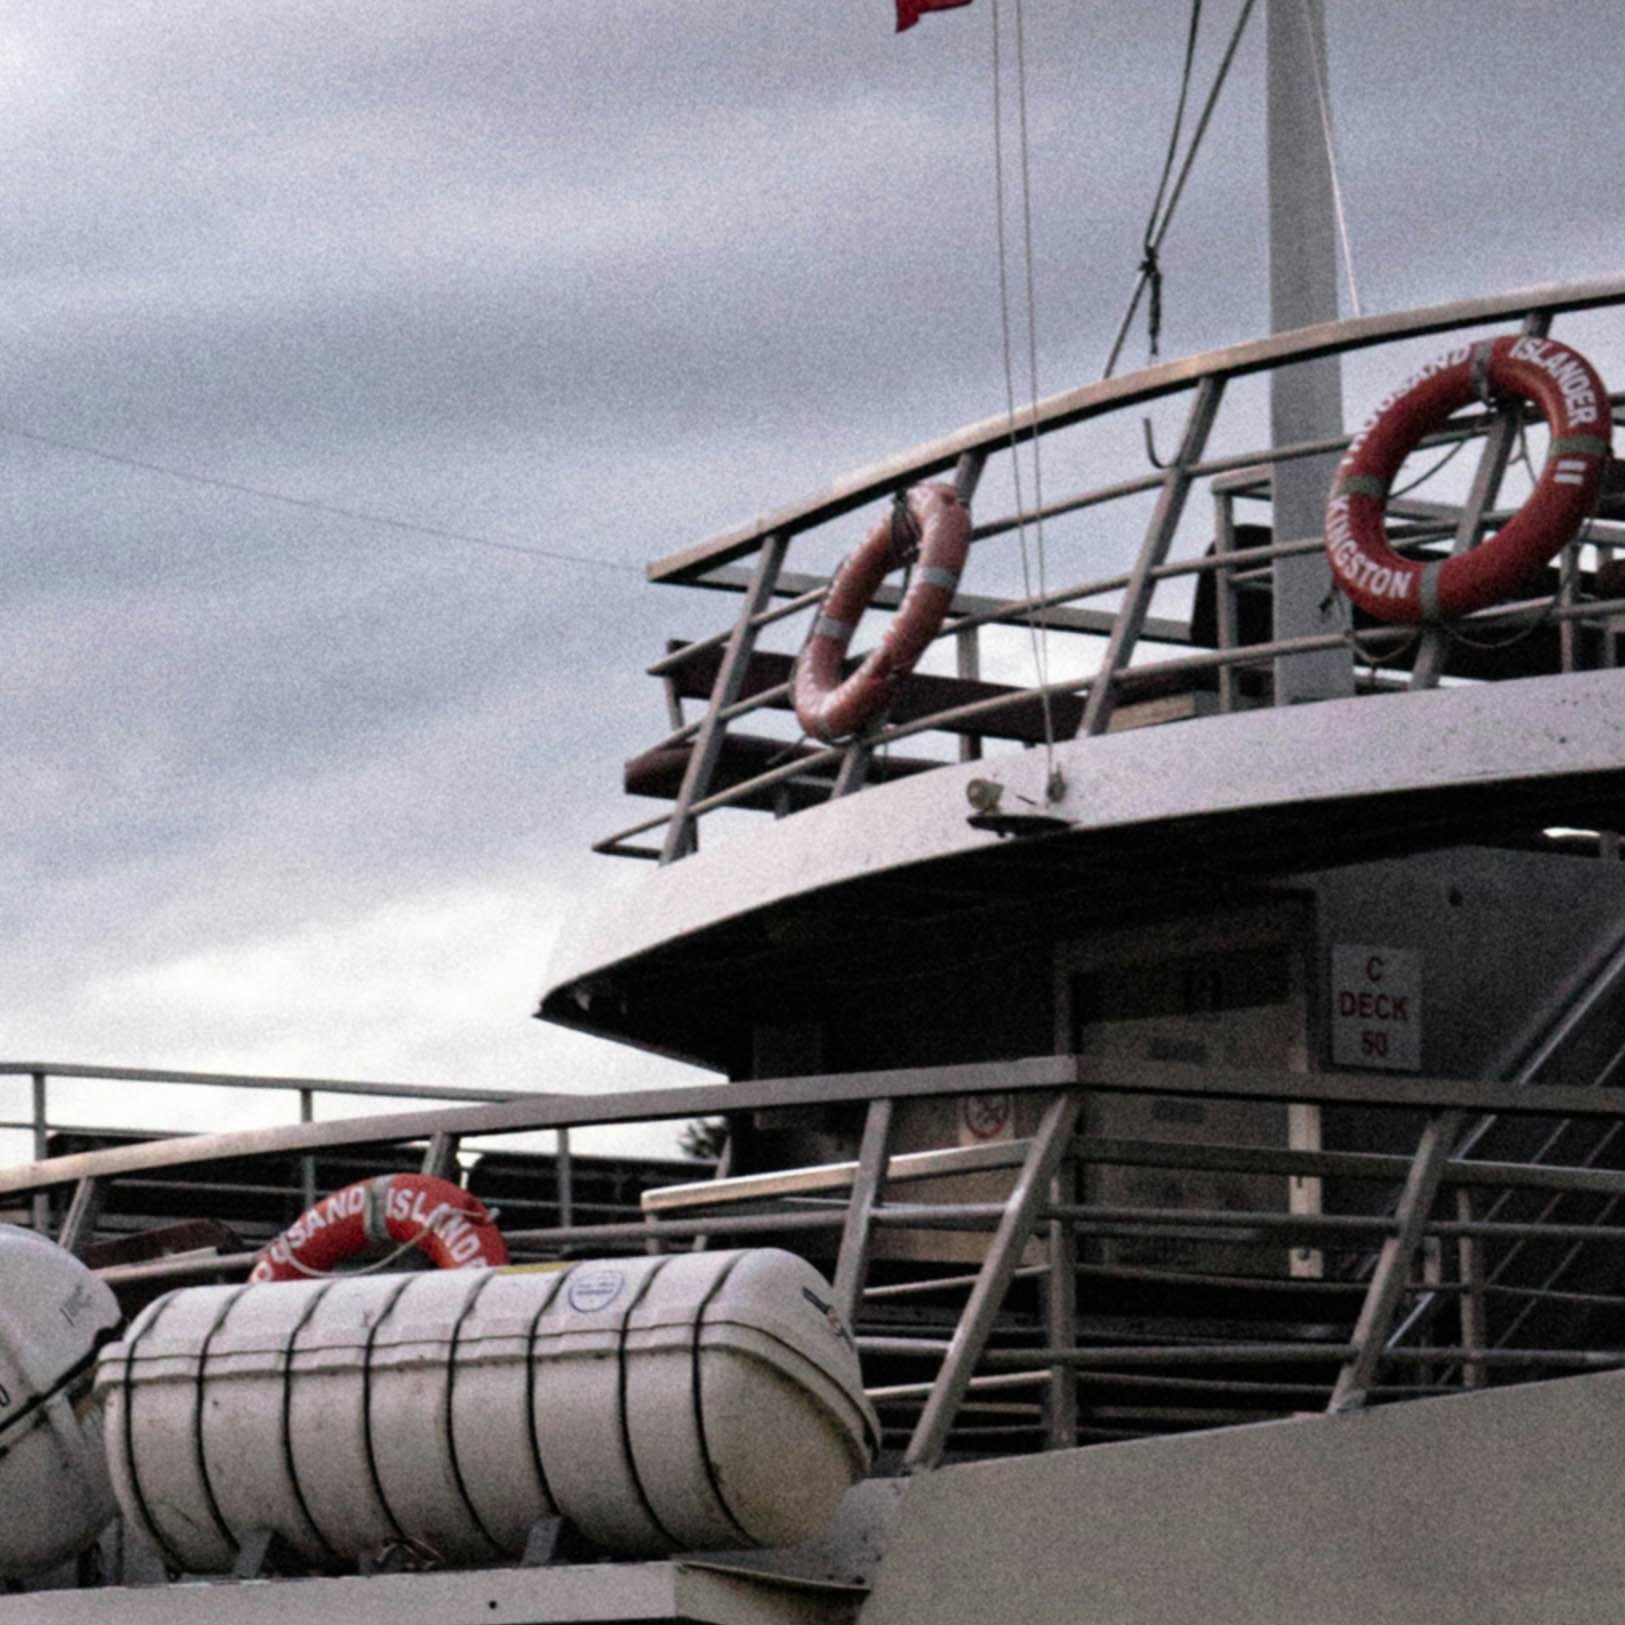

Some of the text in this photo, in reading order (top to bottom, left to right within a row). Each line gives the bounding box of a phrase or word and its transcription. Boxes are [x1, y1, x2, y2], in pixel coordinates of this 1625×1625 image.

[1508, 337, 1598, 428] ISLANDER
[1554, 459, 1588, 485] II
[1324, 494, 1413, 599] KINGSTON
[1367, 956, 1384, 982] C
[1339, 991, 1409, 1022] DECK
